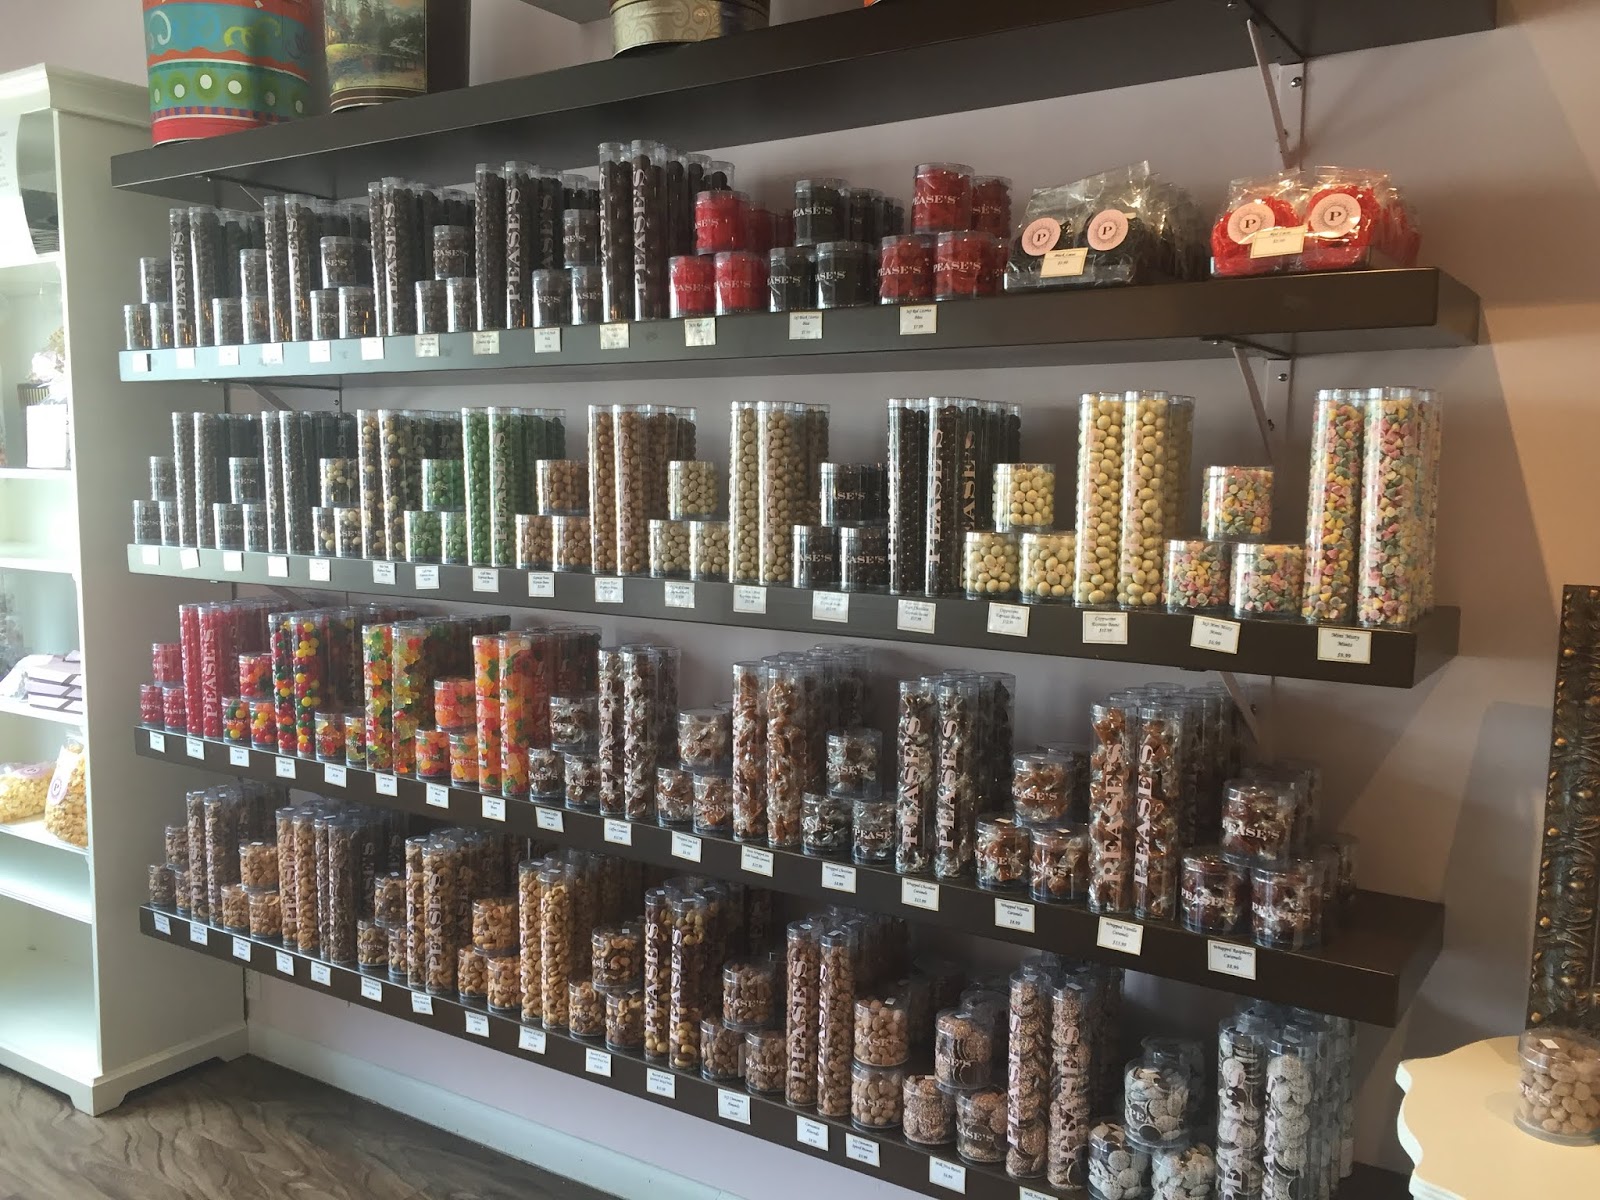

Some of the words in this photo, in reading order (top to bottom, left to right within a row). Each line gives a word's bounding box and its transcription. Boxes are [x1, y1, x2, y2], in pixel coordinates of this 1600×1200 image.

[507, 187, 521, 302] PEASE'S
[633, 168, 648, 291] PEASE'S
[1036, 233, 1047, 242] P
[1102, 226, 1112, 235] P
[1245, 218, 1256, 228] P
[1329, 211, 1342, 221] P
[173, 231, 187, 325] PEASE'S
[933, 261, 981, 272] PEASE'S
[205, 629, 218, 718] PEASE'S
[903, 716, 922, 851] PEASE'S
[939, 720, 958, 849] PEASE'S
[1104, 741, 1125, 884] PEASE'S
[1134, 743, 1154, 887] PEASE'S
[1221, 819, 1281, 840] PEASE'S
[1252, 901, 1311, 922] PEASE'S
[645, 922, 659, 1033] PEASE'S
[791, 960, 807, 1079] PEASE'S
